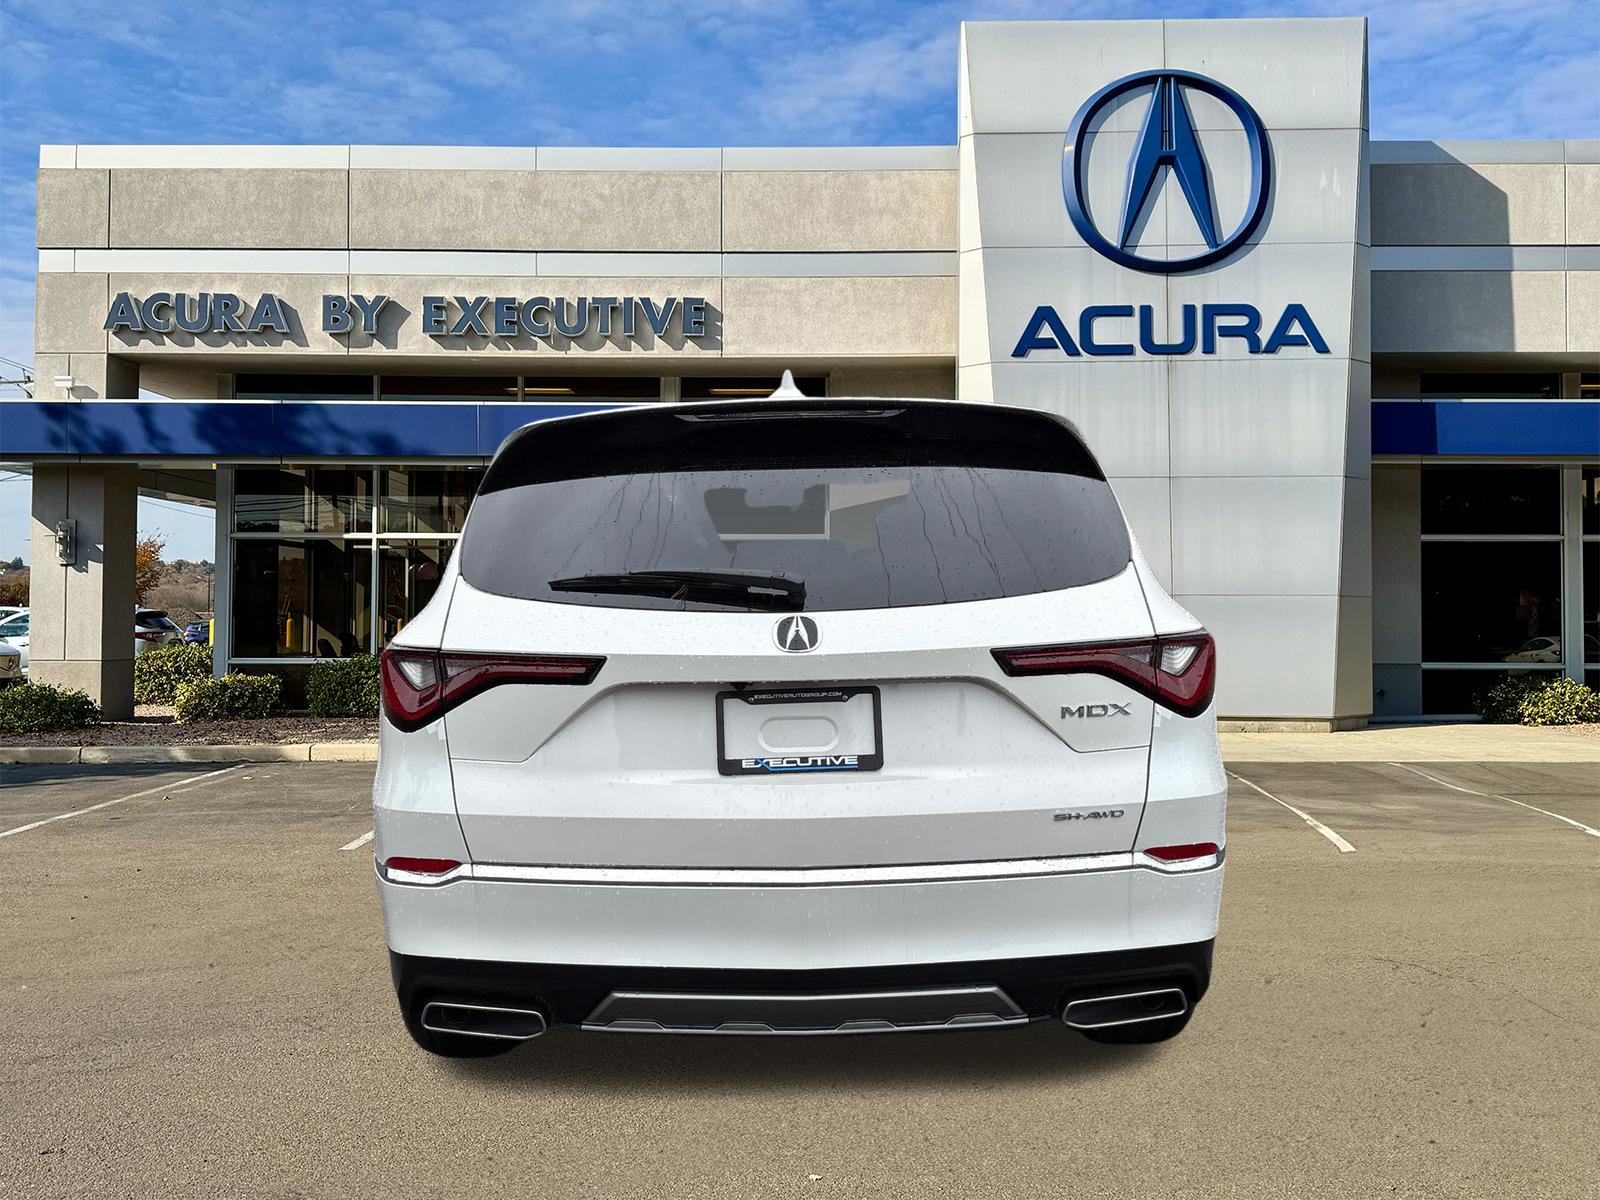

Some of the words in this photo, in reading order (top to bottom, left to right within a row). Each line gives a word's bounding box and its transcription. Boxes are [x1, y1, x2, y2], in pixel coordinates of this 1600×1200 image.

[103, 291, 290, 333] ACURA
[322, 294, 390, 334] BY
[422, 296, 706, 336] EXECUTIVE
[1011, 303, 1331, 357] ACURA
[753, 691, 843, 700] EXECUTIVEAUTOGROUP.COM
[1060, 702, 1132, 719] MDX
[741, 755, 859, 769] EXECUTIVE
